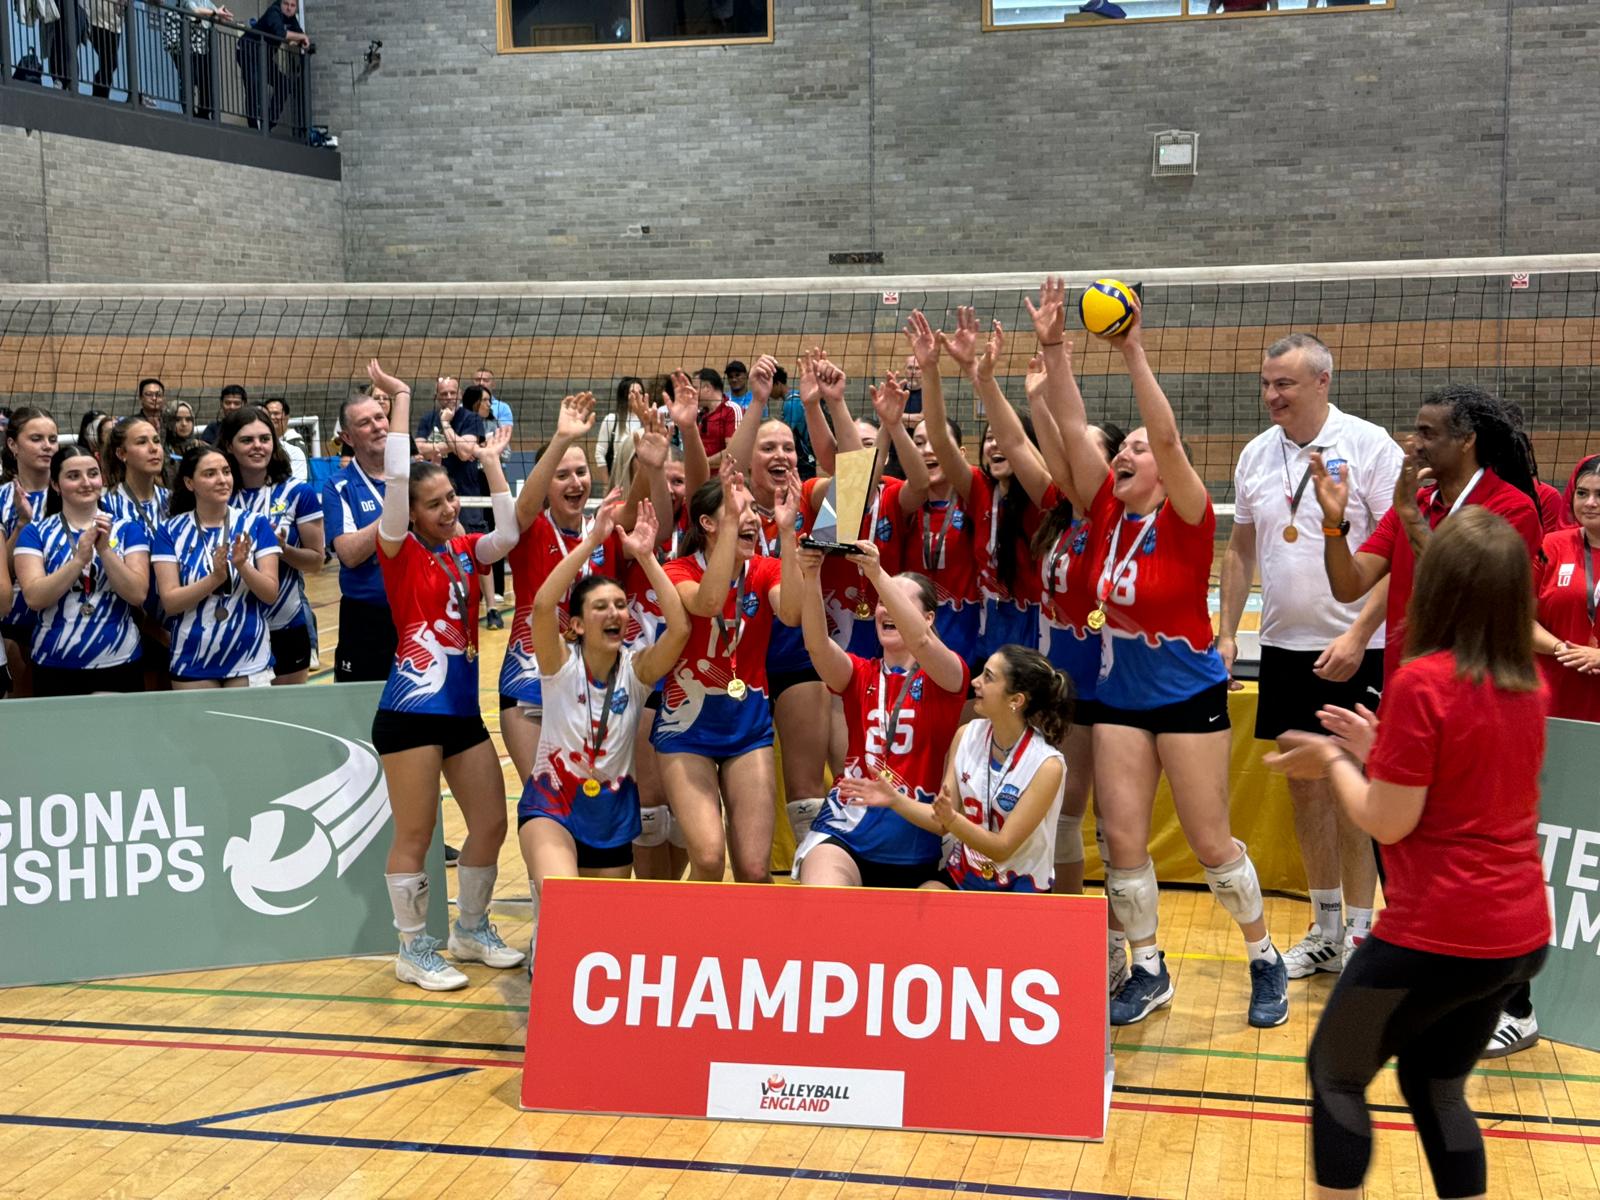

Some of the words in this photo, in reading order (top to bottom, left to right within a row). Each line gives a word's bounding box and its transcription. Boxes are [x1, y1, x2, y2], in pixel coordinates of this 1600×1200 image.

[361, 499, 376, 512] DG
[696, 616, 746, 658] 17
[865, 708, 916, 755] 25
[0, 838, 206, 906] SHIPS
[572, 951, 1060, 1045] CHAMPIONS
[759, 1096, 830, 1112] ENGLAND
[761, 1073, 850, 1099] VOLLEYBALL
